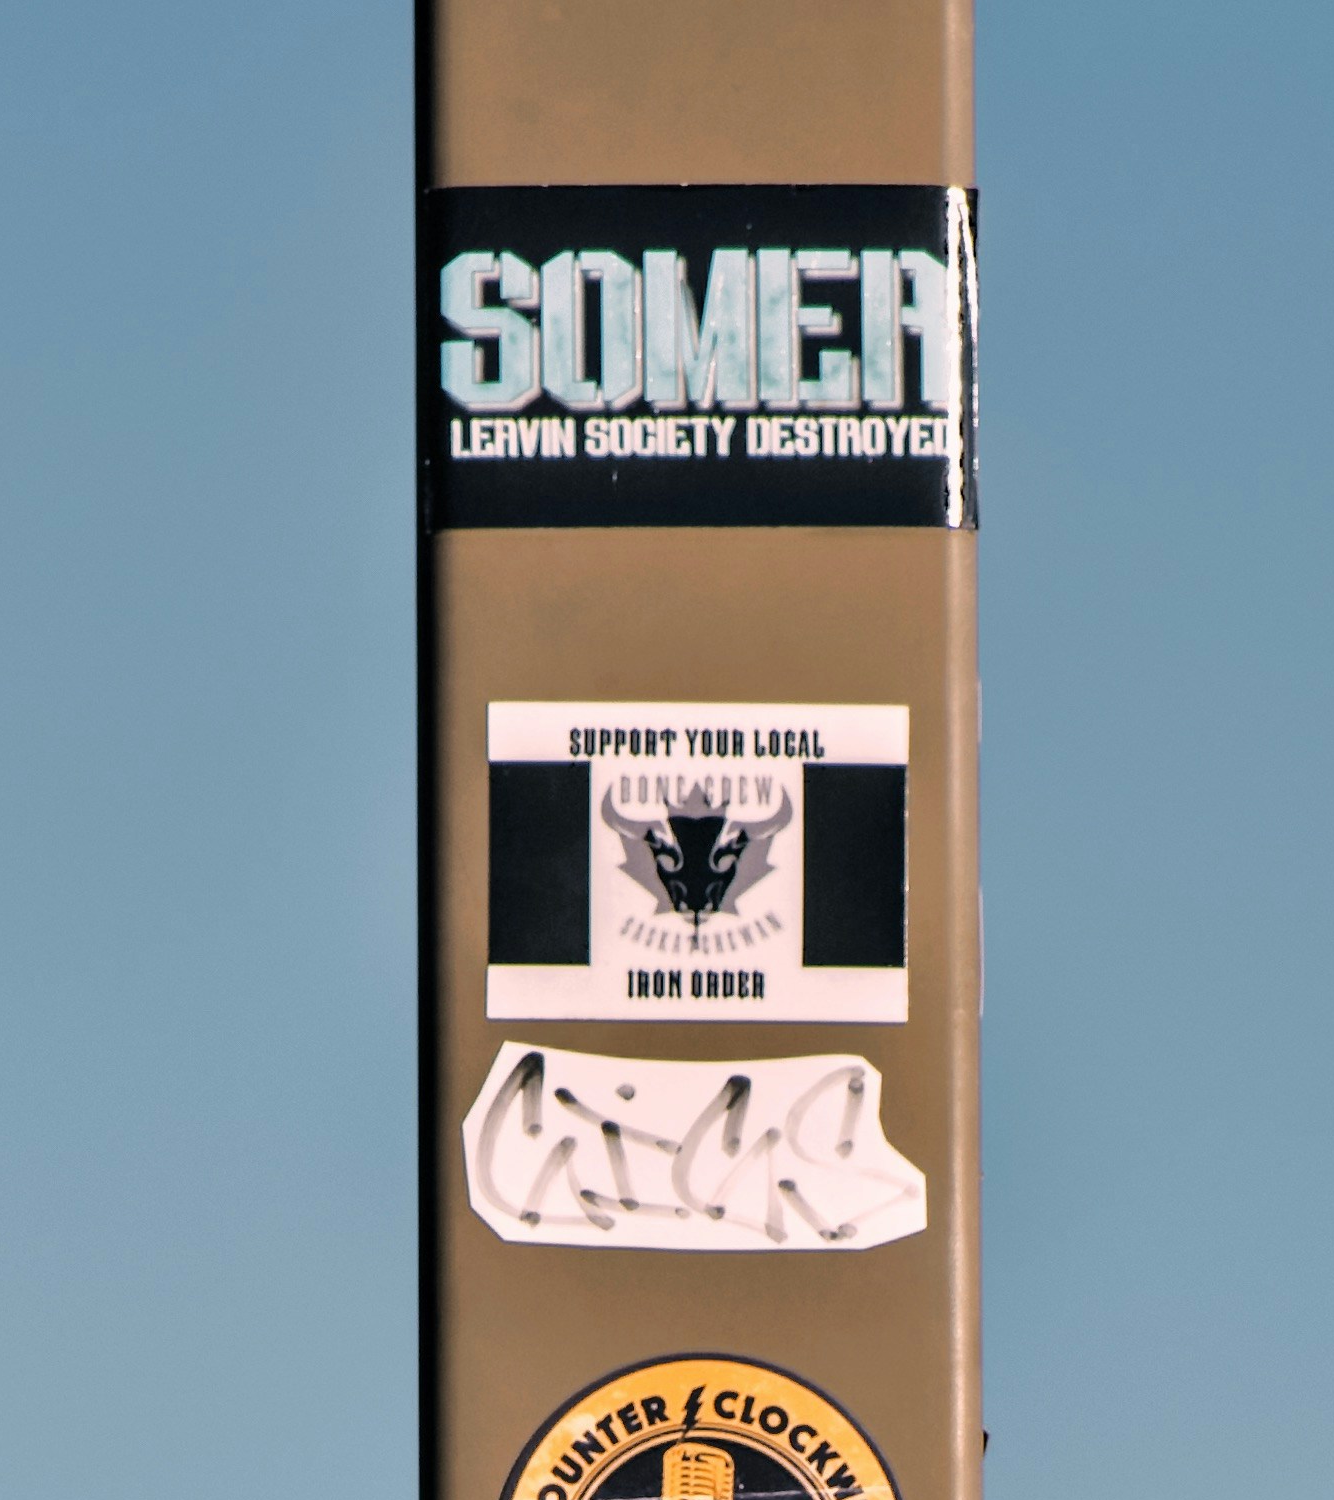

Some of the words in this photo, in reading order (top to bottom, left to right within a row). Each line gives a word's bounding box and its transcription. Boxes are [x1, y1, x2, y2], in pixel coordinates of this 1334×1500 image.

[585, 417, 736, 457] SOCIETY
[569, 728, 677, 758] SUPPORT
[684, 728, 745, 758] YOUR
[754, 728, 825, 758] LOCAL
[628, 969, 681, 999] IRON
[691, 969, 765, 999] ORDER
